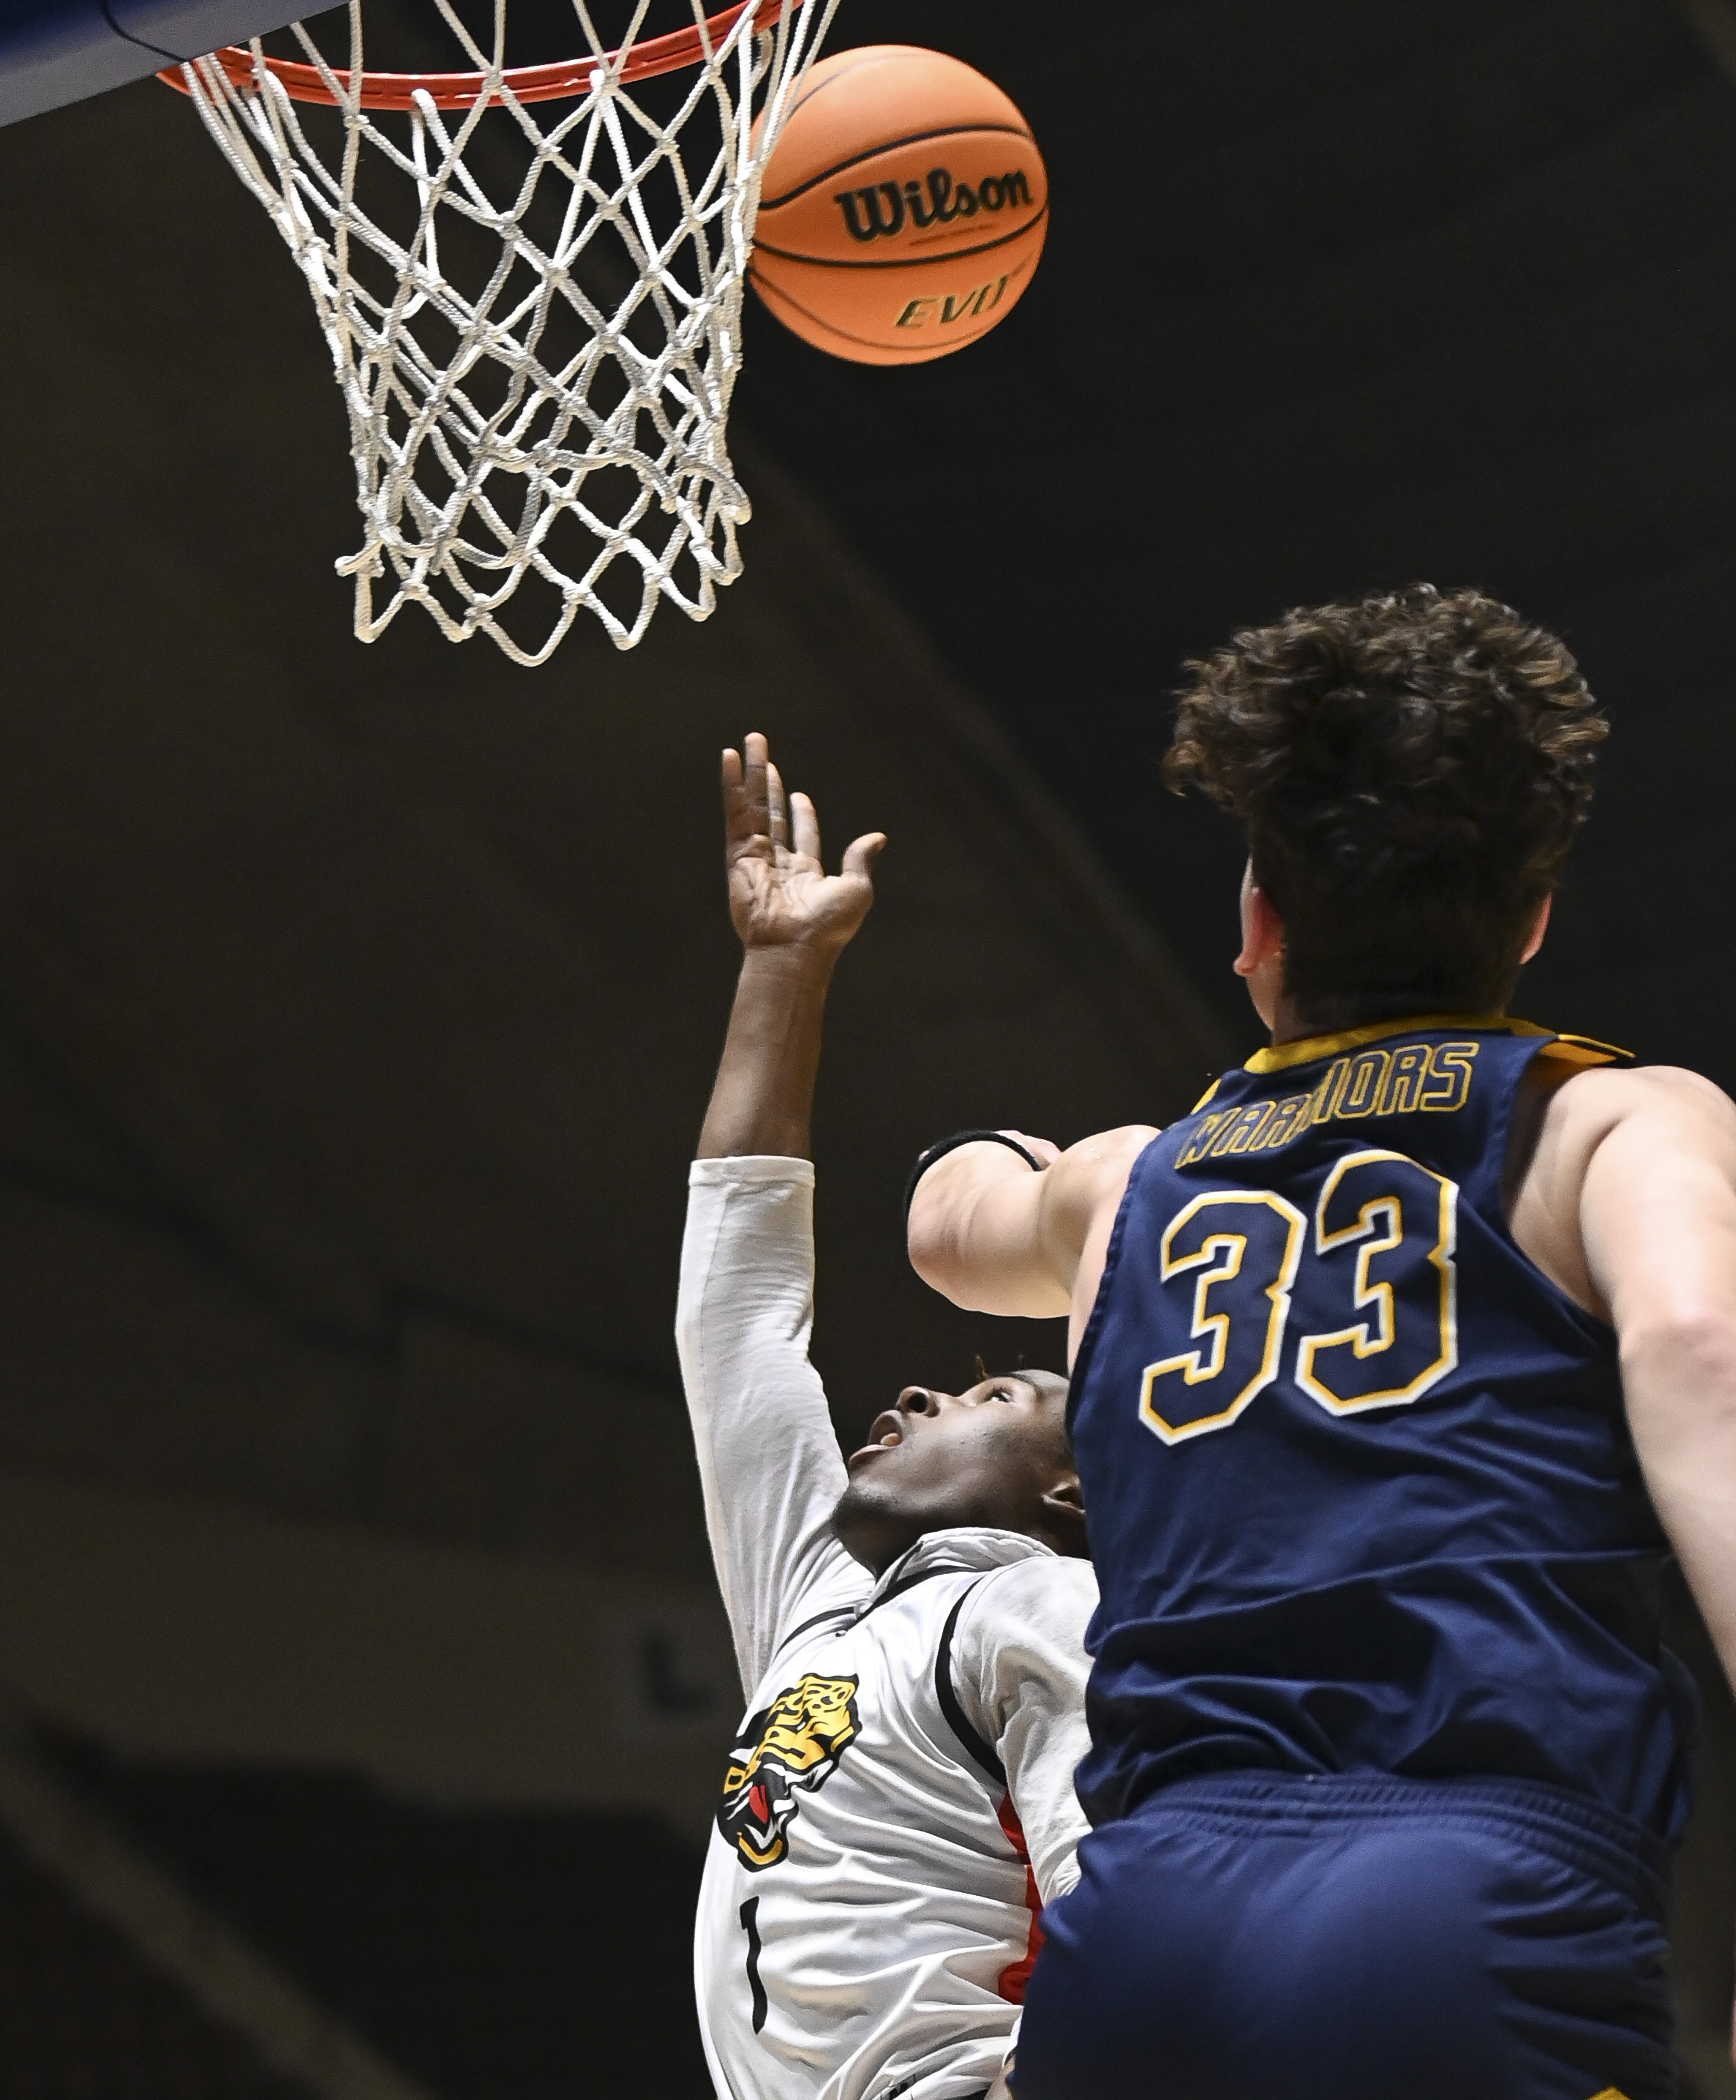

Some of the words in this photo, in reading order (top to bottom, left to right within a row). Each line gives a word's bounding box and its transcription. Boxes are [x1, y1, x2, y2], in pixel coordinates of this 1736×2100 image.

[833, 168, 1032, 243] Wilson
[1173, 1042, 1480, 1171] WARIORS
[1139, 1150, 1459, 1447] 33
[739, 1896, 768, 2036] 1
